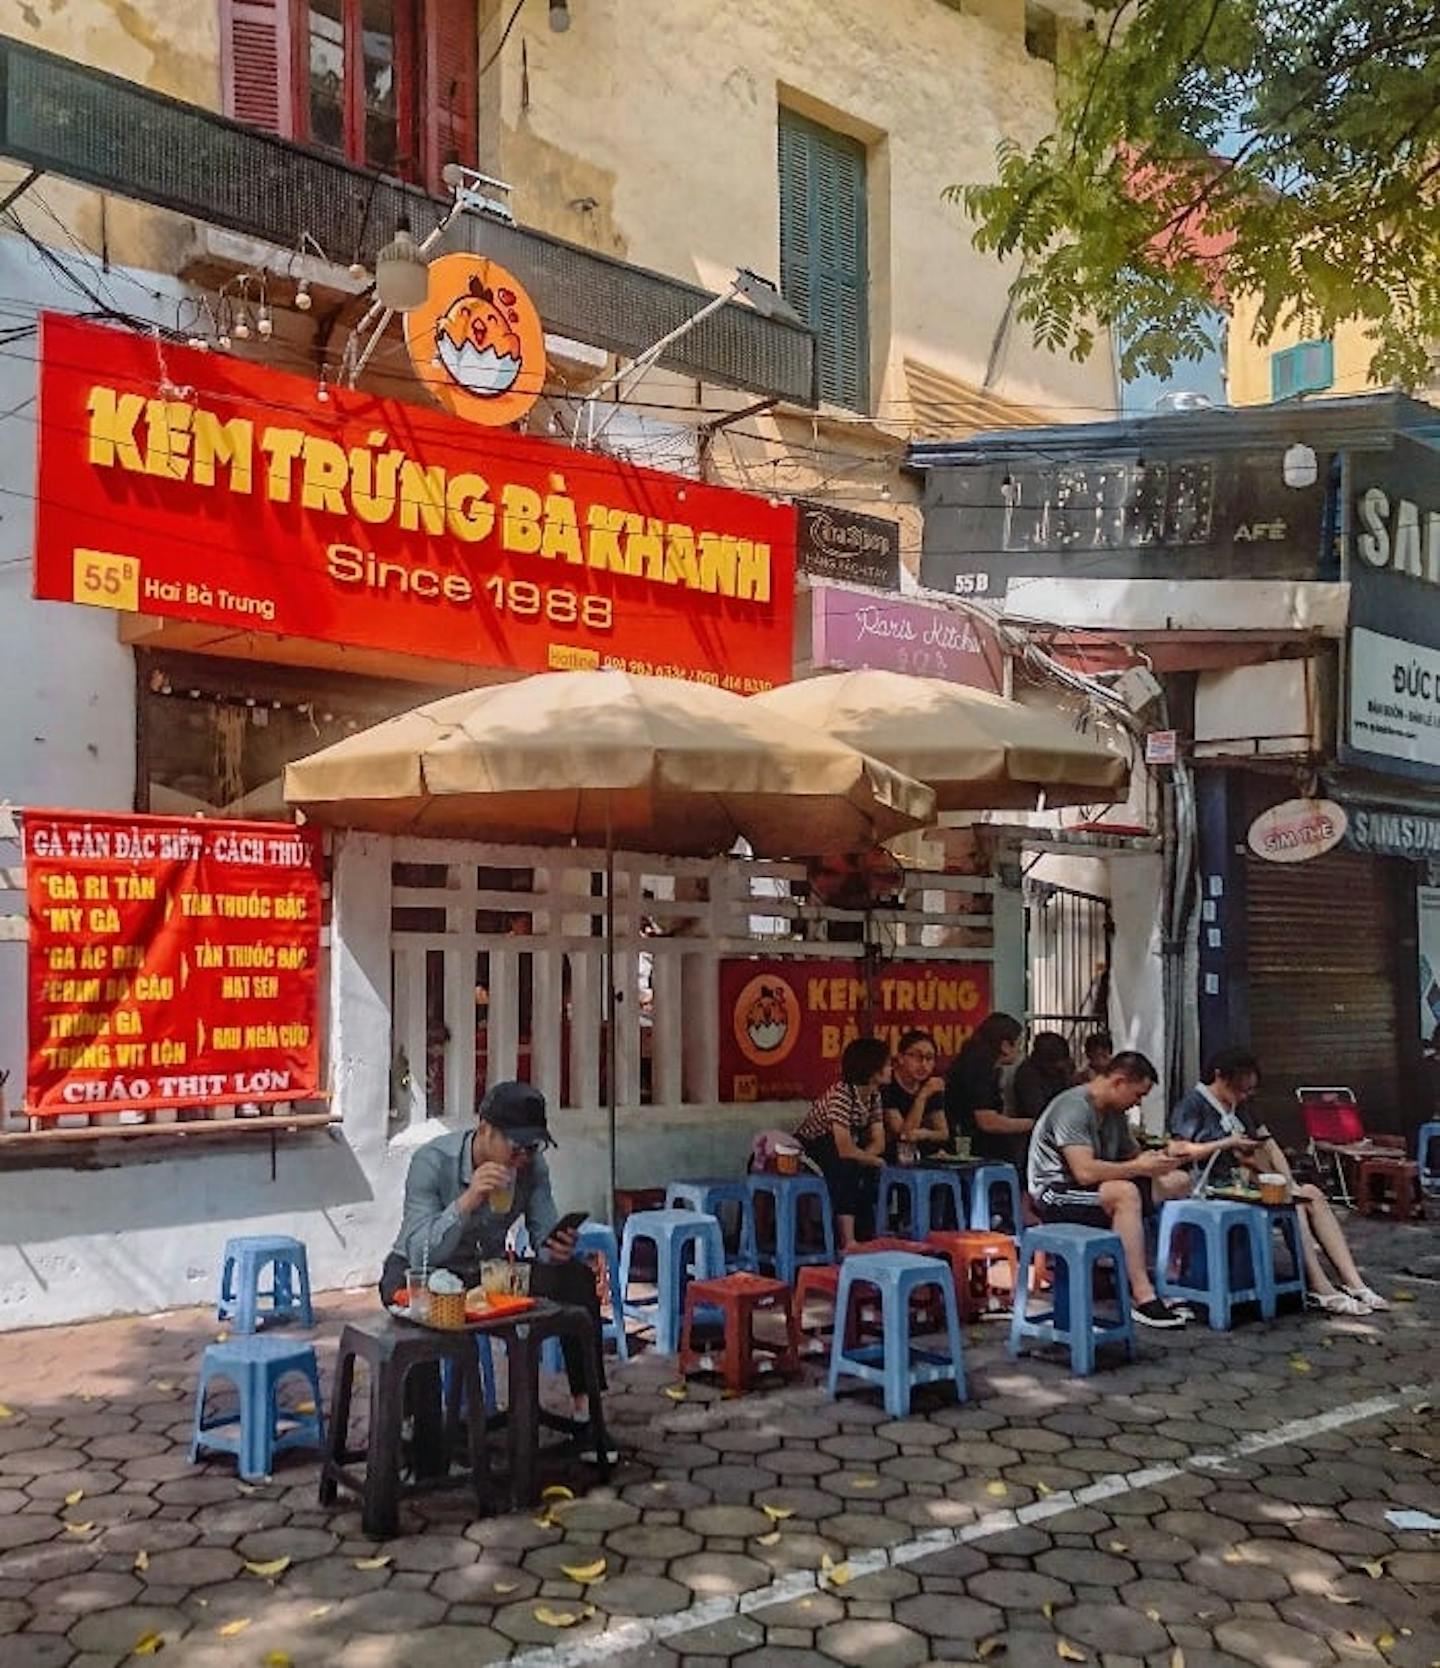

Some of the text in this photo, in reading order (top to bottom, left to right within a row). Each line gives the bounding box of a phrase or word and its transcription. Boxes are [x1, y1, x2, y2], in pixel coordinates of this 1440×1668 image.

[86, 384, 254, 495] KEM
[262, 426, 496, 542] TRỨNG
[502, 473, 584, 565] BÀ
[588, 503, 772, 603] KHANH
[144, 577, 182, 602] Hai
[185, 583, 213, 607] Bà
[326, 543, 614, 630] Since 1988
[33, 822, 64, 857] GÀ
[1264, 831, 1298, 852] SIM
[84, 875, 109, 900] RI
[89, 904, 120, 933] GÀ
[879, 970, 980, 1012] TRỨNG
[116, 1009, 142, 1035] GÀ
[62, 1068, 290, 1103] CHÁO THỊT LỢN
